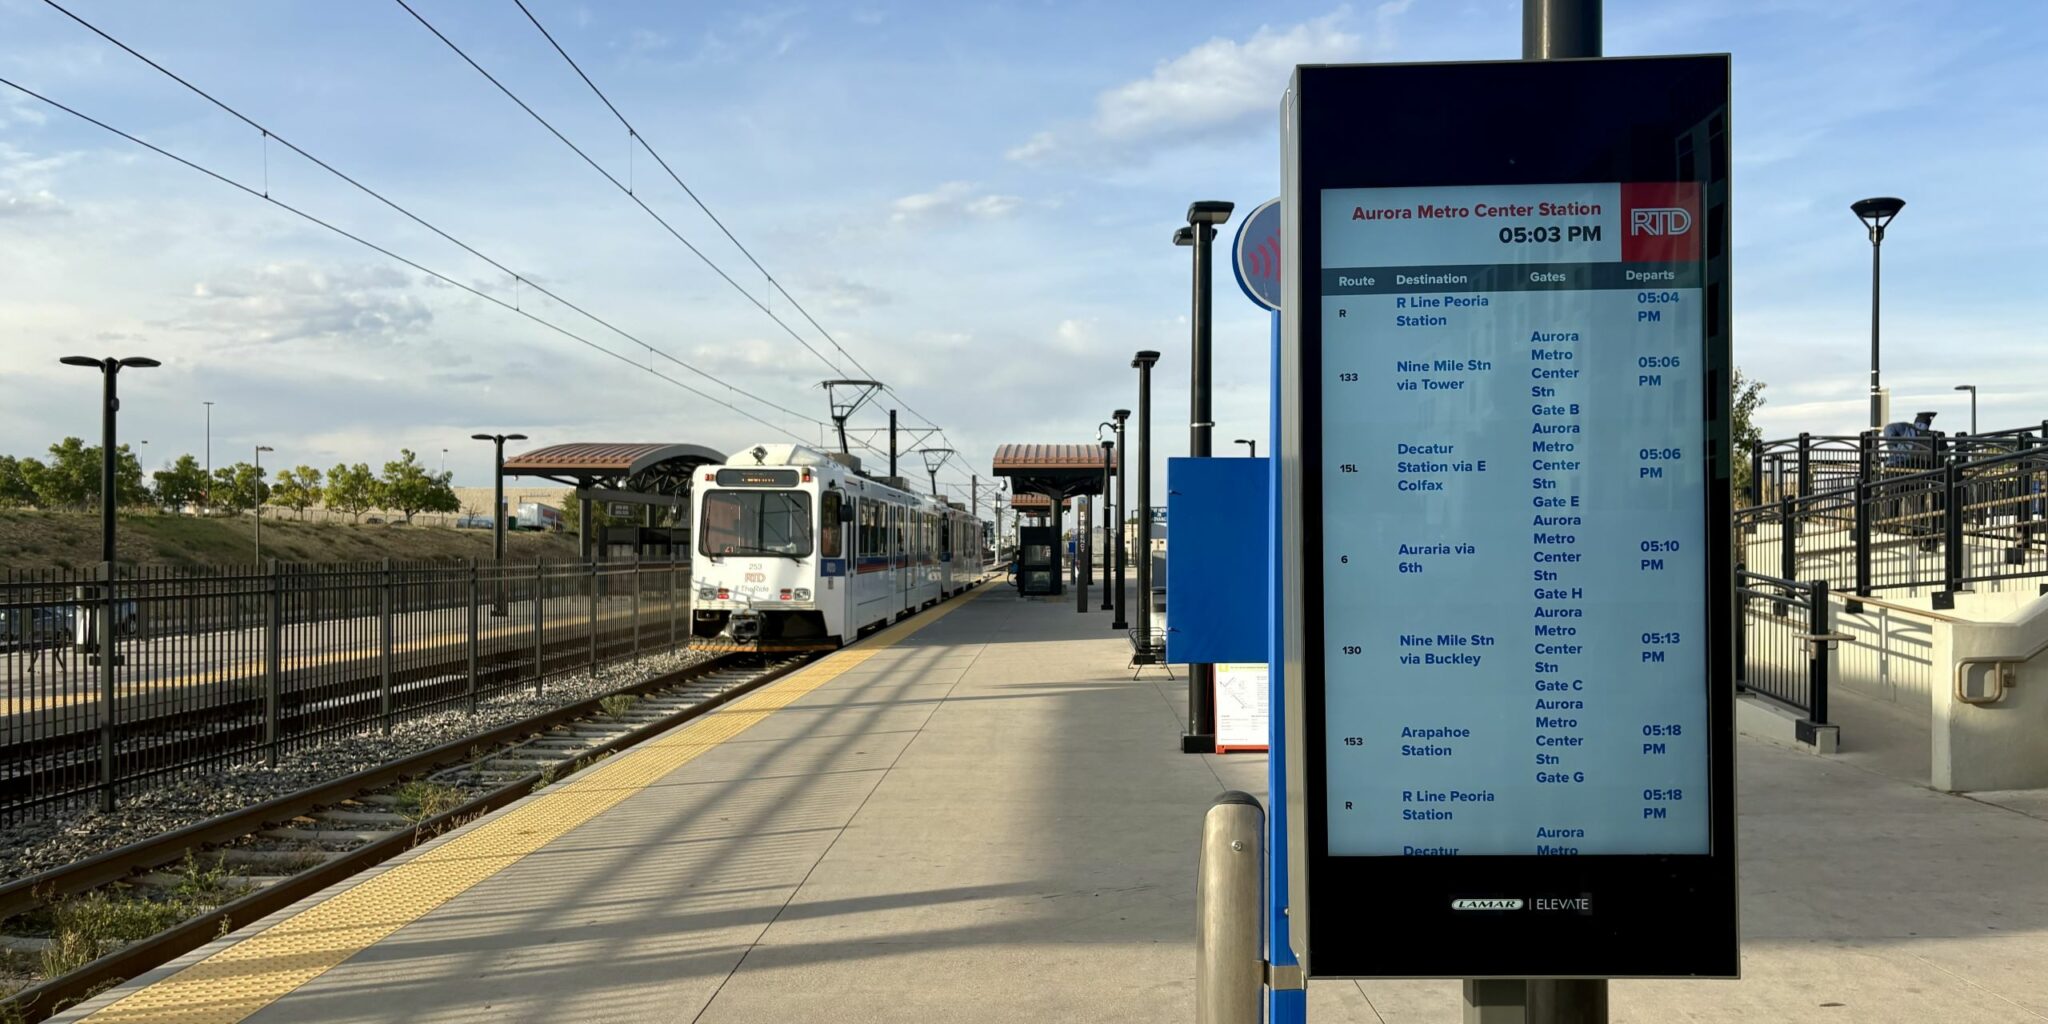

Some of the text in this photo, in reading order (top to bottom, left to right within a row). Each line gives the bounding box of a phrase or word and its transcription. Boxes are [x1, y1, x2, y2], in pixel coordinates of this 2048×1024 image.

[1352, 202, 1601, 220] Aurora Metro Center Station
[1631, 208, 1691, 235] RTD
[1499, 226, 1601, 243] 05:03 PM
[1339, 277, 1375, 286] Route
[1397, 273, 1467, 284] Destination
[1530, 272, 1566, 281] Gates
[1626, 270, 1675, 282] Departs
[1397, 295, 1488, 308] R Line Peoria
[1638, 292, 1679, 303] 05:04
[1339, 309, 1346, 317] R
[1638, 311, 1660, 322] PM
[1397, 315, 1446, 326] Station
[1531, 331, 1579, 342] Aurora
[1532, 349, 1572, 360] Metro
[1398, 360, 1491, 372] Nine Mile Stn
[1639, 357, 1680, 367] 05:06
[1340, 373, 1358, 381] 133
[1532, 368, 1579, 378] Center
[1397, 379, 1464, 390] via Tower
[1639, 375, 1661, 386] PM
[1532, 386, 1554, 397] Stn
[1532, 404, 1579, 415] Gate B
[1532, 423, 1579, 434] Aurora
[1398, 444, 1453, 454] Decatur
[1533, 441, 1574, 452] Metro
[1640, 449, 1681, 459] 05:06
[1340, 464, 1358, 472] 15L
[1398, 461, 1486, 472] Station via E
[1533, 460, 1580, 470] Center
[1640, 467, 1662, 478] PM
[1398, 480, 1442, 491] Colfax
[1533, 478, 1556, 489] Stn
[1533, 496, 1579, 507] Gate E
[1533, 515, 1581, 525] Aurora
[1534, 533, 1575, 544] Metro
[1399, 543, 1475, 555] Auraria via
[1641, 541, 1679, 552] 05:10
[1534, 552, 1581, 562] Center
[1399, 562, 1422, 573] 6th
[1641, 559, 1663, 570] PM
[744, 572, 767, 583] RTD
[1534, 570, 1557, 580] Stn
[1534, 588, 1582, 599] Gate H
[1534, 607, 1582, 617] Aurora
[1535, 625, 1576, 636] Metro
[1400, 635, 1494, 646] Nine Mile Stn
[1642, 633, 1680, 644] 05:13
[1343, 646, 1361, 654] 130
[1535, 644, 1582, 654] Center
[1400, 653, 1481, 666] via Buckley
[1642, 651, 1664, 662] PM
[1535, 662, 1558, 672] Stn
[1535, 680, 1582, 691] Gate C
[1536, 699, 1583, 709] Aurora
[1536, 717, 1577, 727] Metro
[1401, 727, 1470, 740] Arapahoe
[1643, 725, 1681, 736] 05:18
[1536, 735, 1583, 746] Center
[1402, 745, 1451, 756] Station
[1644, 744, 1665, 754] PM
[1536, 754, 1559, 764] Stn
[1537, 772, 1584, 783] Gate G
[1403, 790, 1494, 801] R Line Peoria
[1644, 789, 1682, 800] 05:18
[1403, 809, 1452, 820] Station
[1644, 808, 1666, 818] PM
[1537, 827, 1584, 838] Aurora
[1403, 845, 1459, 856] Decatur
[1536, 845, 1578, 856] Metro
[1458, 898, 1589, 910] LAMAR ELEVATE
